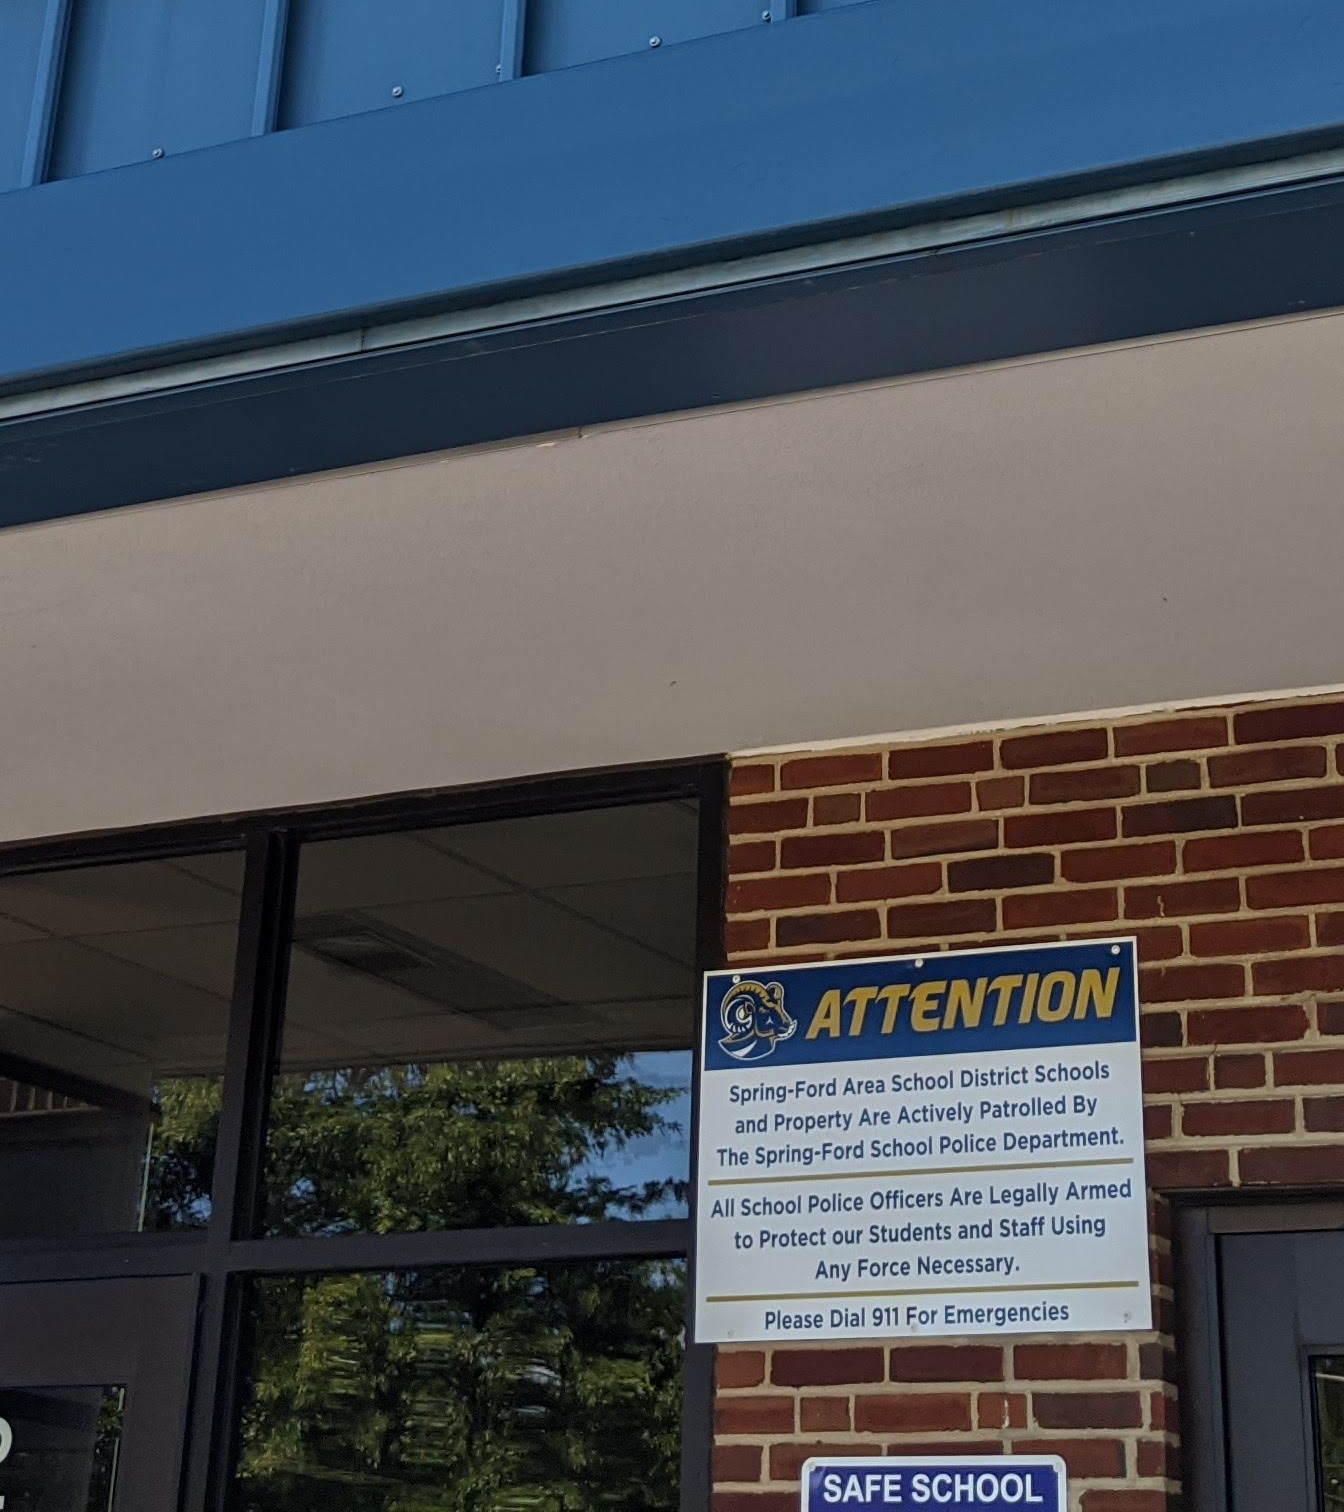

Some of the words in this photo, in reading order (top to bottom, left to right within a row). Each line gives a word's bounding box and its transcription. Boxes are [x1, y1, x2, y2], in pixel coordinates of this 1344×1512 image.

[805, 967, 1120, 1040] ATTENTION
[729, 1078, 837, 1105] Spring-Ford
[842, 1076, 885, 1096] Area
[891, 1071, 954, 1093] School
[960, 1066, 1029, 1088] District
[1034, 1060, 1110, 1083] Schools
[735, 1113, 768, 1135] and
[774, 1108, 853, 1132] Property
[858, 1107, 892, 1127] Are
[897, 1102, 973, 1125] Actively
[980, 1096, 1066, 1119] Patrolled
[1073, 1095, 1097, 1116] By
[717, 1147, 749, 1167] The
[755, 1140, 864, 1167] Spring-Ford
[870, 1136, 934, 1158] School
[939, 1132, 997, 1154] Police
[1003, 1126, 1125, 1153] Department.
[711, 1197, 735, 1218] All
[741, 1194, 802, 1216] School
[808, 1190, 864, 1213] Police
[869, 1189, 944, 1210] Officers
[949, 1186, 983, 1206] Are
[989, 1182, 1059, 1207] Legally
[1065, 1179, 1132, 1201] Armed
[734, 1231, 753, 1249] to
[759, 1227, 826, 1248] Protect
[832, 1227, 863, 1245] our
[869, 1221, 952, 1243] Students
[958, 1219, 993, 1240] and
[999, 1217, 1045, 1238] Staff
[1051, 1216, 1106, 1238] Using
[815, 1260, 851, 1281] Any
[857, 1256, 911, 1277] Force
[917, 1254, 1020, 1277] Necessary.
[765, 1310, 825, 1330] Please
[830, 1307, 866, 1328] Dial
[872, 1307, 900, 1326] 911
[906, 1306, 938, 1326] For
[944, 1301, 1069, 1327] Emergencies
[822, 1474, 902, 1504] SAFE
[911, 1472, 1043, 1503] SCHOOL
